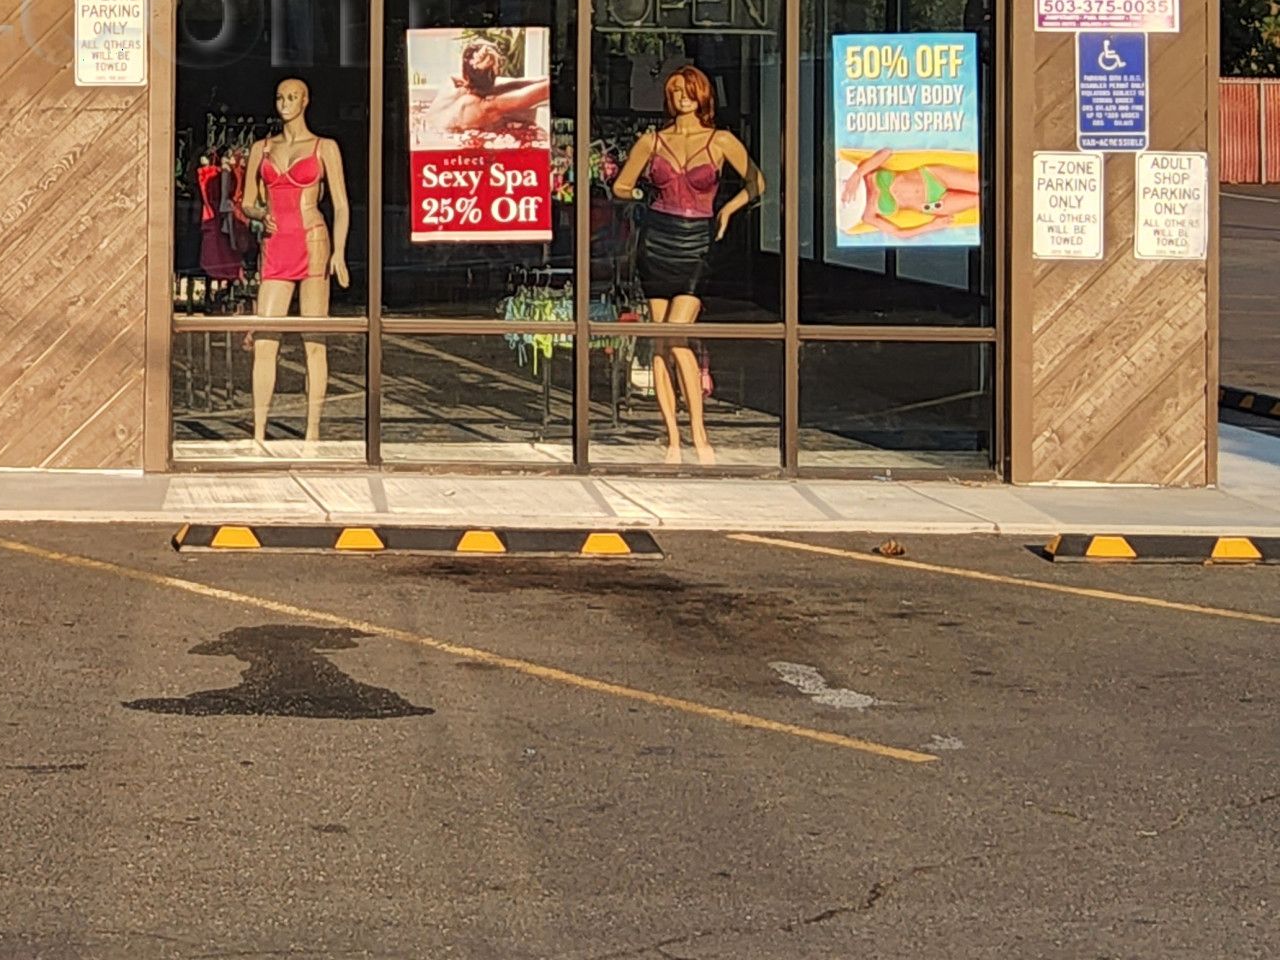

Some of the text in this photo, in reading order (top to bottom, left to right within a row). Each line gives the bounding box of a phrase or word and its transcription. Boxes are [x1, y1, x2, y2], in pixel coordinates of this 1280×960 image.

[81, 4, 140, 19] PARKING
[1043, 0, 1169, 13] 503-375-0035
[93, 21, 128, 35] ONLY
[81, 40, 97, 49] ALL
[845, 44, 965, 79] 50% OFF
[846, 84, 964, 107] EARTHLY BODY
[846, 111, 965, 132] COOLING SPRAY
[443, 155, 484, 166] select
[1040, 160, 1094, 174] T-ZONE
[1150, 157, 1192, 170] ADULT
[422, 162, 538, 195] Sexy Spa
[1037, 177, 1097, 192] PARKING
[1154, 172, 1190, 185] SHOP
[1142, 187, 1200, 200] PARKING
[1049, 195, 1084, 208] ONLY
[422, 196, 543, 225] 25% Off
[1154, 202, 1188, 215] ONLY
[1036, 213, 1097, 224] ALL OTHERS
[1073, 225, 1086, 234] BE
